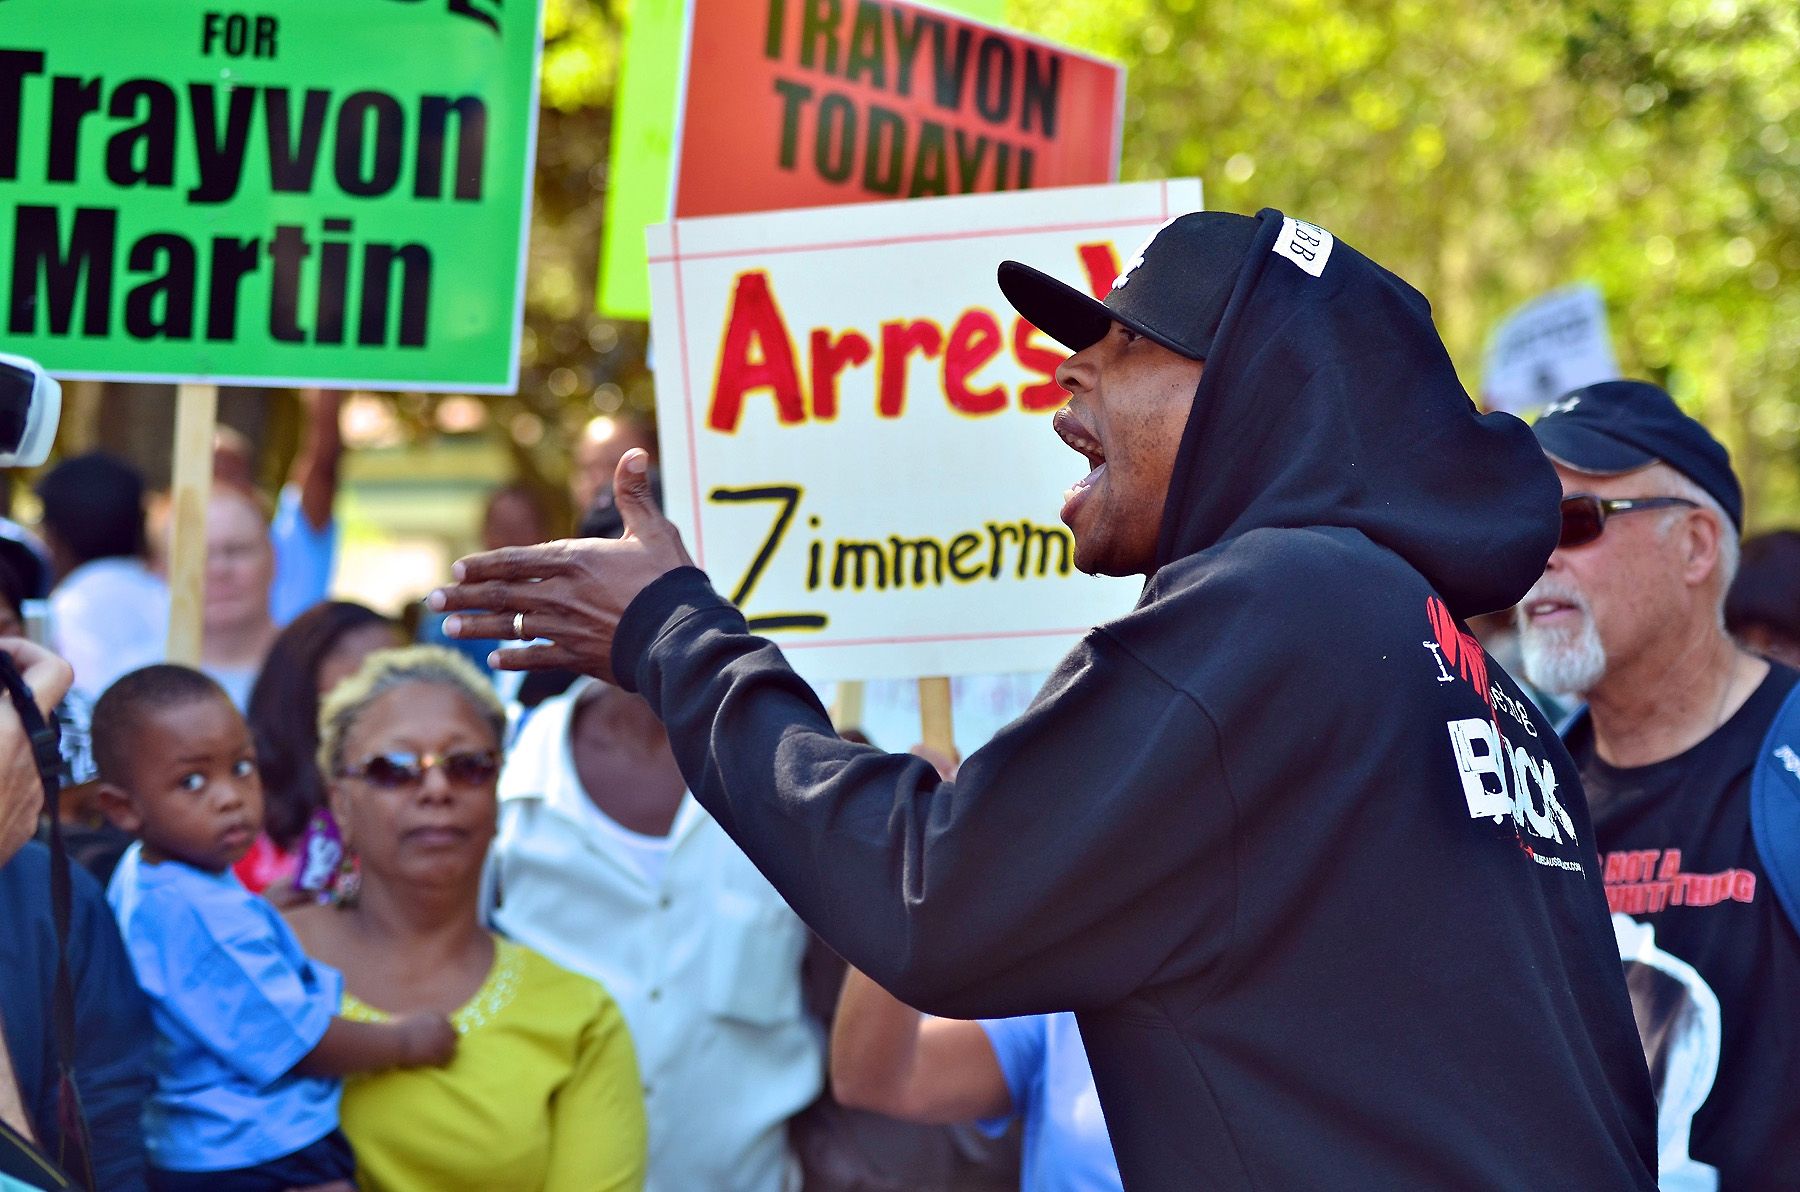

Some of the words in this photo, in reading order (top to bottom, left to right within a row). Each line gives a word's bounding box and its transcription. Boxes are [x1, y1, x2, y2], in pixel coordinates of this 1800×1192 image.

[203, 13, 279, 59] FOR
[765, 0, 1061, 139] TRAYVON
[0, 49, 489, 204] Trayvon
[8, 205, 433, 348] Martin
[1423, 641, 1455, 683] I
[1604, 851, 1661, 883] NOT
[1658, 848, 1681, 881] A
